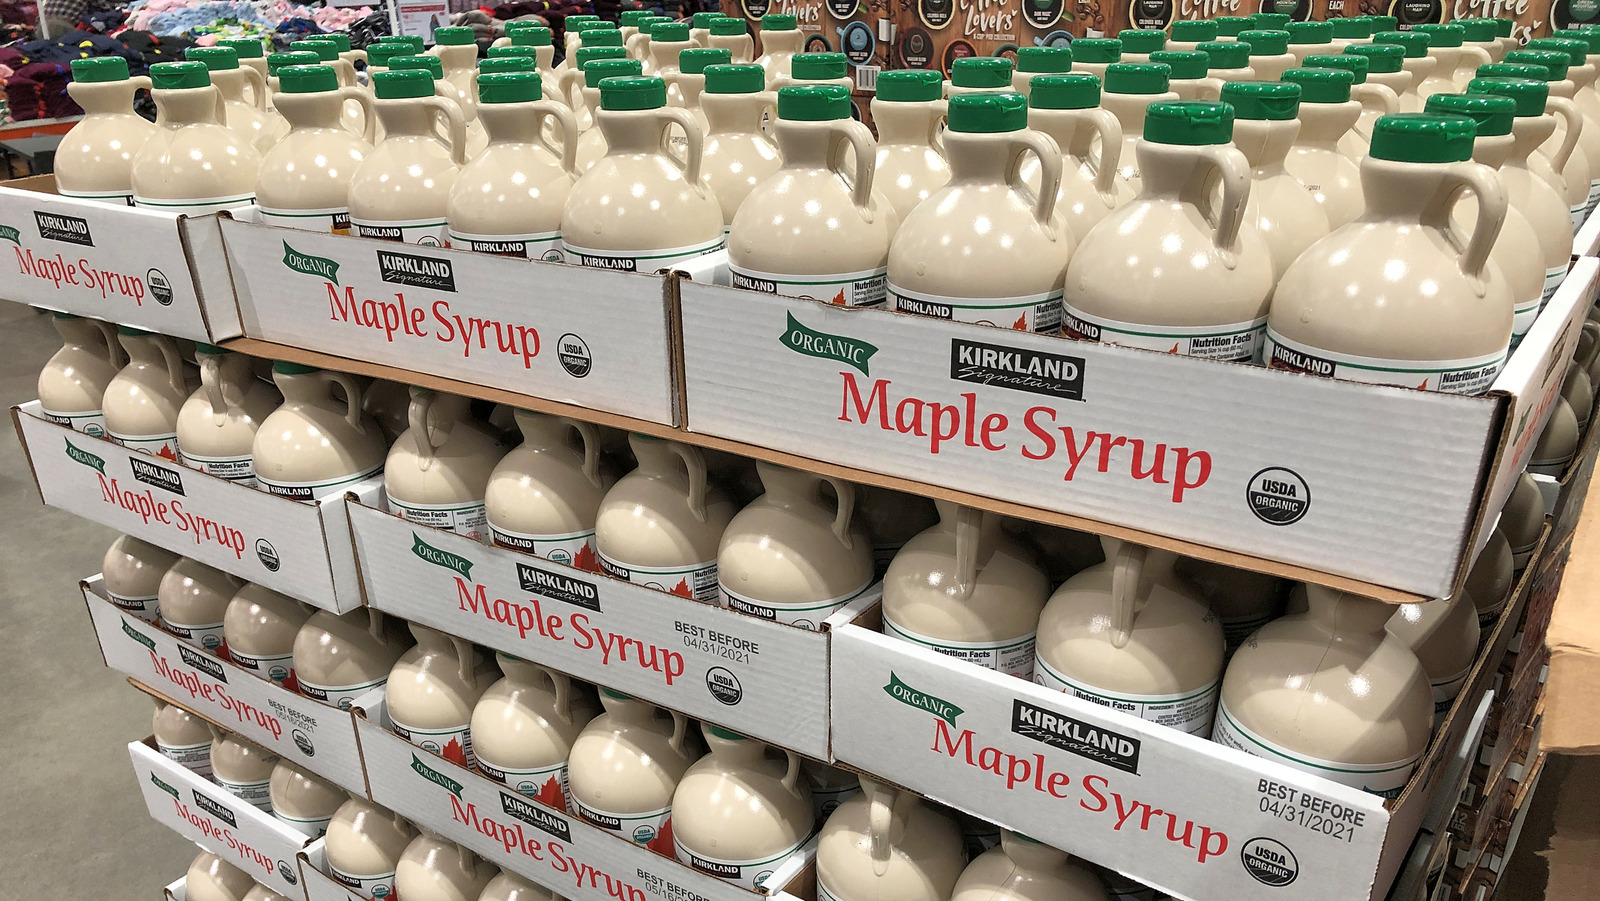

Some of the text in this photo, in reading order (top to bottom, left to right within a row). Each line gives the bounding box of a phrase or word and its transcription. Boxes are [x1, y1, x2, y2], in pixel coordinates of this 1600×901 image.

[1328, 1, 1344, 10] EACH
[964, 5, 1013, 35] Lovers
[37, 214, 87, 234] KIRKLAND
[42, 228, 90, 242] Signature
[360, 227, 400, 237] KIRKLAND
[473, 242, 524, 252] KIRKLAND
[288, 253, 333, 279] ORGANIC
[382, 256, 450, 279] KIRKLAND
[582, 256, 634, 270] KIRKLAND
[13, 246, 145, 307] Maple Syrup
[386, 270, 453, 288] Signature
[733, 275, 774, 292] KIRKLAND
[854, 279, 881, 290] Nutrition
[898, 298, 950, 318] KIRKLAND
[324, 282, 540, 369] Maple Syrup
[563, 342, 584, 357] USDA
[791, 329, 864, 365] ORGANIC
[1192, 333, 1251, 348] Nutrition Facts
[563, 355, 587, 368] ORGANIC
[958, 345, 1078, 381] KIRKLAND
[1273, 344, 1332, 375] KIRKLAND
[958, 366, 1077, 394] Signature
[1442, 365, 1497, 383] Nutrition Facts
[837, 371, 1212, 504] Maple Syrup
[69, 447, 101, 470] ORGANIC
[132, 460, 180, 485] KIRKLAND
[270, 486, 311, 496] KIRKLAND
[1261, 478, 1297, 498] USDA
[406, 509, 430, 518] Nutrition
[1255, 495, 1299, 512] ORGANIC
[96, 472, 246, 560] Maple Syrup
[494, 532, 532, 548] KIRKLAND
[418, 545, 466, 574] ORGANIC
[521, 567, 595, 600] KIRKLAND
[695, 568, 717, 579] Nutritio
[729, 598, 774, 618] KIRKLAND
[453, 576, 685, 686] Maple Syrup
[674, 620, 760, 655] BEST BEFORE
[180, 647, 223, 675] KIRKLAND
[683, 635, 750, 665] 04/31/2021
[935, 646, 990, 658] Nutrition Facts
[711, 683, 737, 699] ORGANIC
[713, 673, 734, 688] USDA
[148, 649, 282, 741] Maple Syrup
[892, 683, 954, 720] ORGANIC
[1075, 690, 1136, 711] Nutrition Facts
[267, 699, 318, 728] BEST BEFORE
[1018, 704, 1135, 759] KIRKLAND
[1018, 724, 1133, 770] Signature
[416, 763, 459, 794] ORGANIC
[930, 717, 1229, 864] Maple Syrup
[195, 792, 234, 821] KIRKLAND
[504, 796, 567, 833] KIRKLAND
[1257, 778, 1366, 828] BEST BEFORE
[580, 807, 619, 826] KIRKLAND
[1258, 796, 1355, 843] 04/31/2021
[174, 798, 223, 842] Maple
[223, 829, 274, 875] Syrup
[449, 792, 647, 901] Maple Syrup
[692, 857, 739, 874] KIRKLAND
[1255, 846, 1287, 867] USDA
[637, 868, 664, 888] BEST
[1249, 858, 1288, 879] ORGANIC
